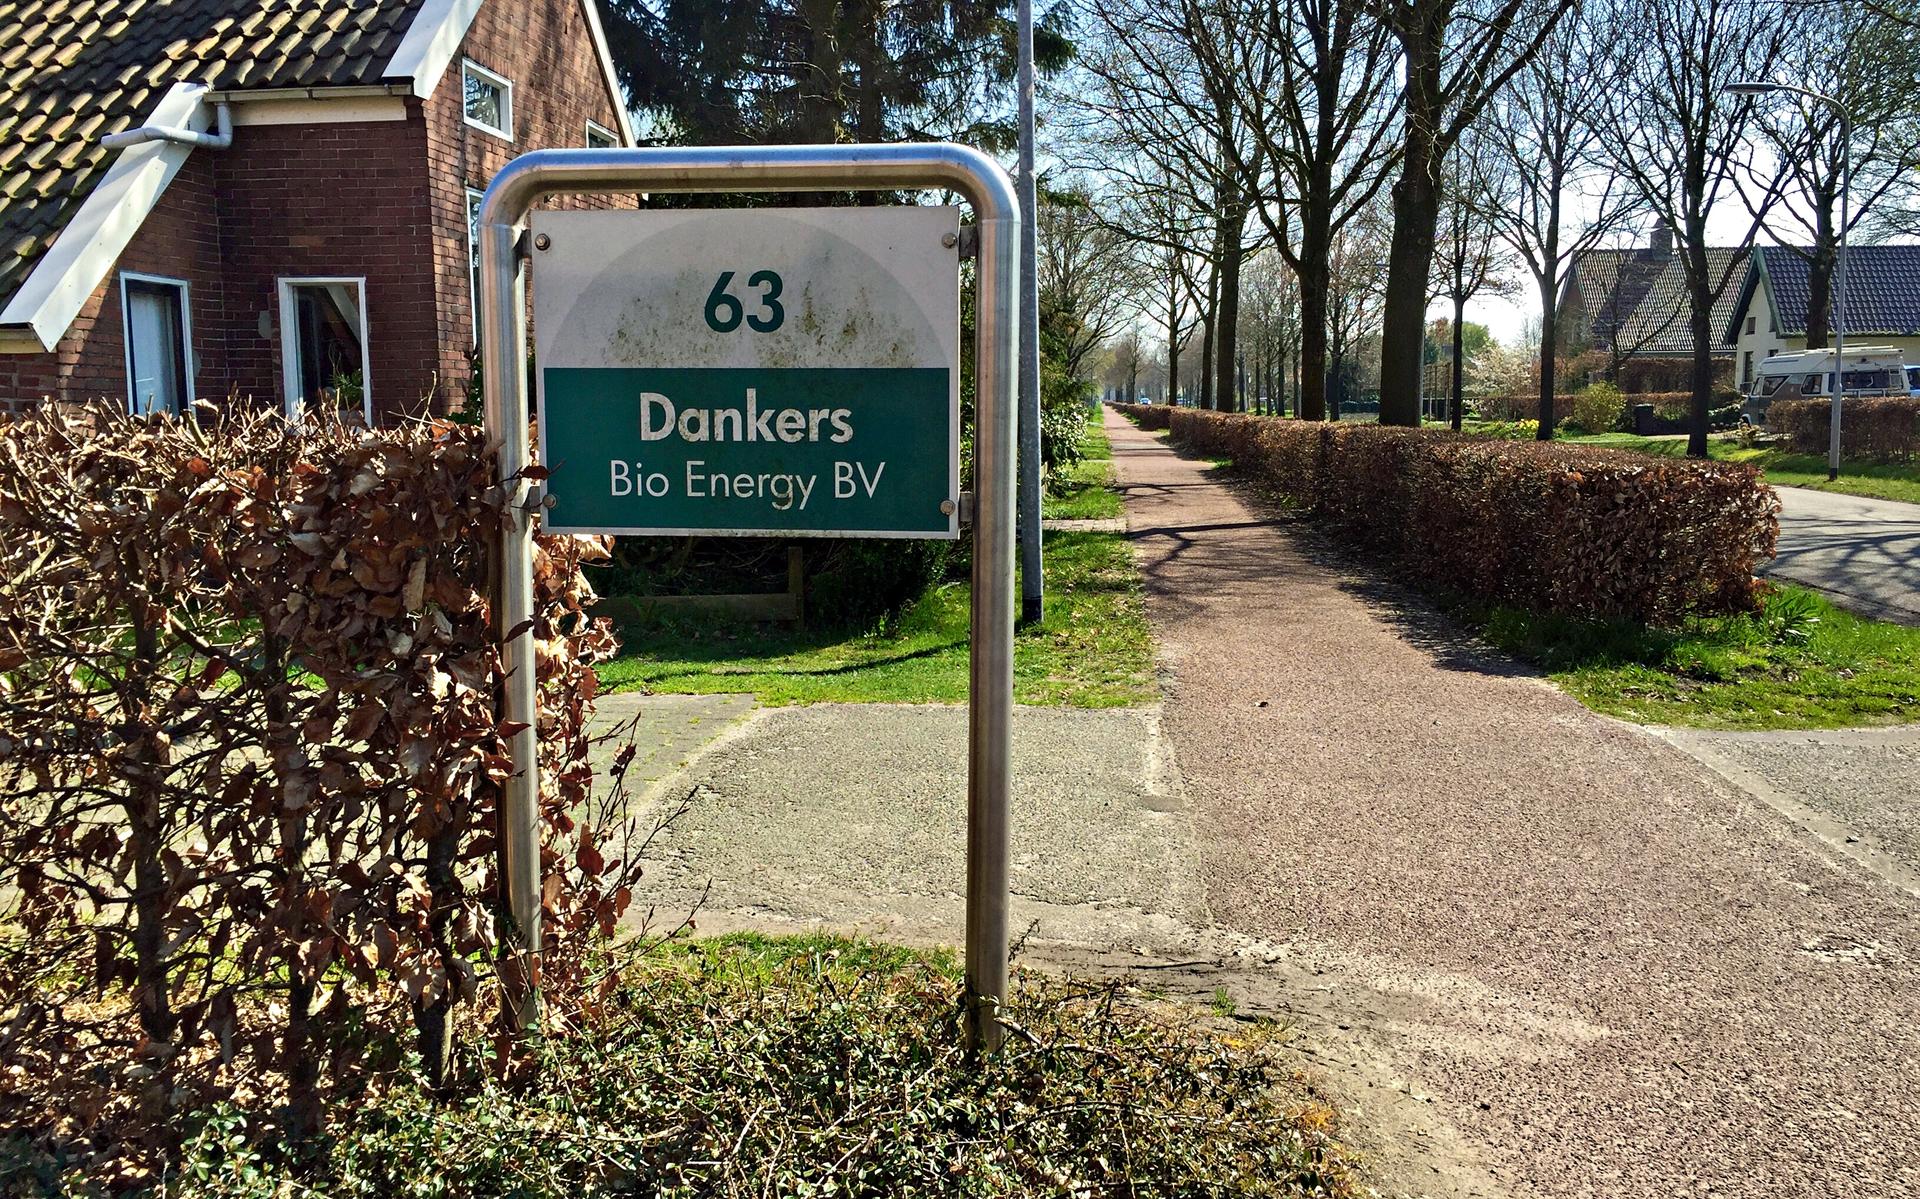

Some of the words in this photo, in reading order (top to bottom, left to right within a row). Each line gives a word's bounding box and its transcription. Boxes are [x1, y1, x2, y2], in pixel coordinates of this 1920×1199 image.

[704, 270, 785, 333] 63
[639, 388, 854, 443] Dankers
[610, 459, 670, 497] Bio
[686, 460, 817, 511] Energy
[834, 461, 886, 499] BV
